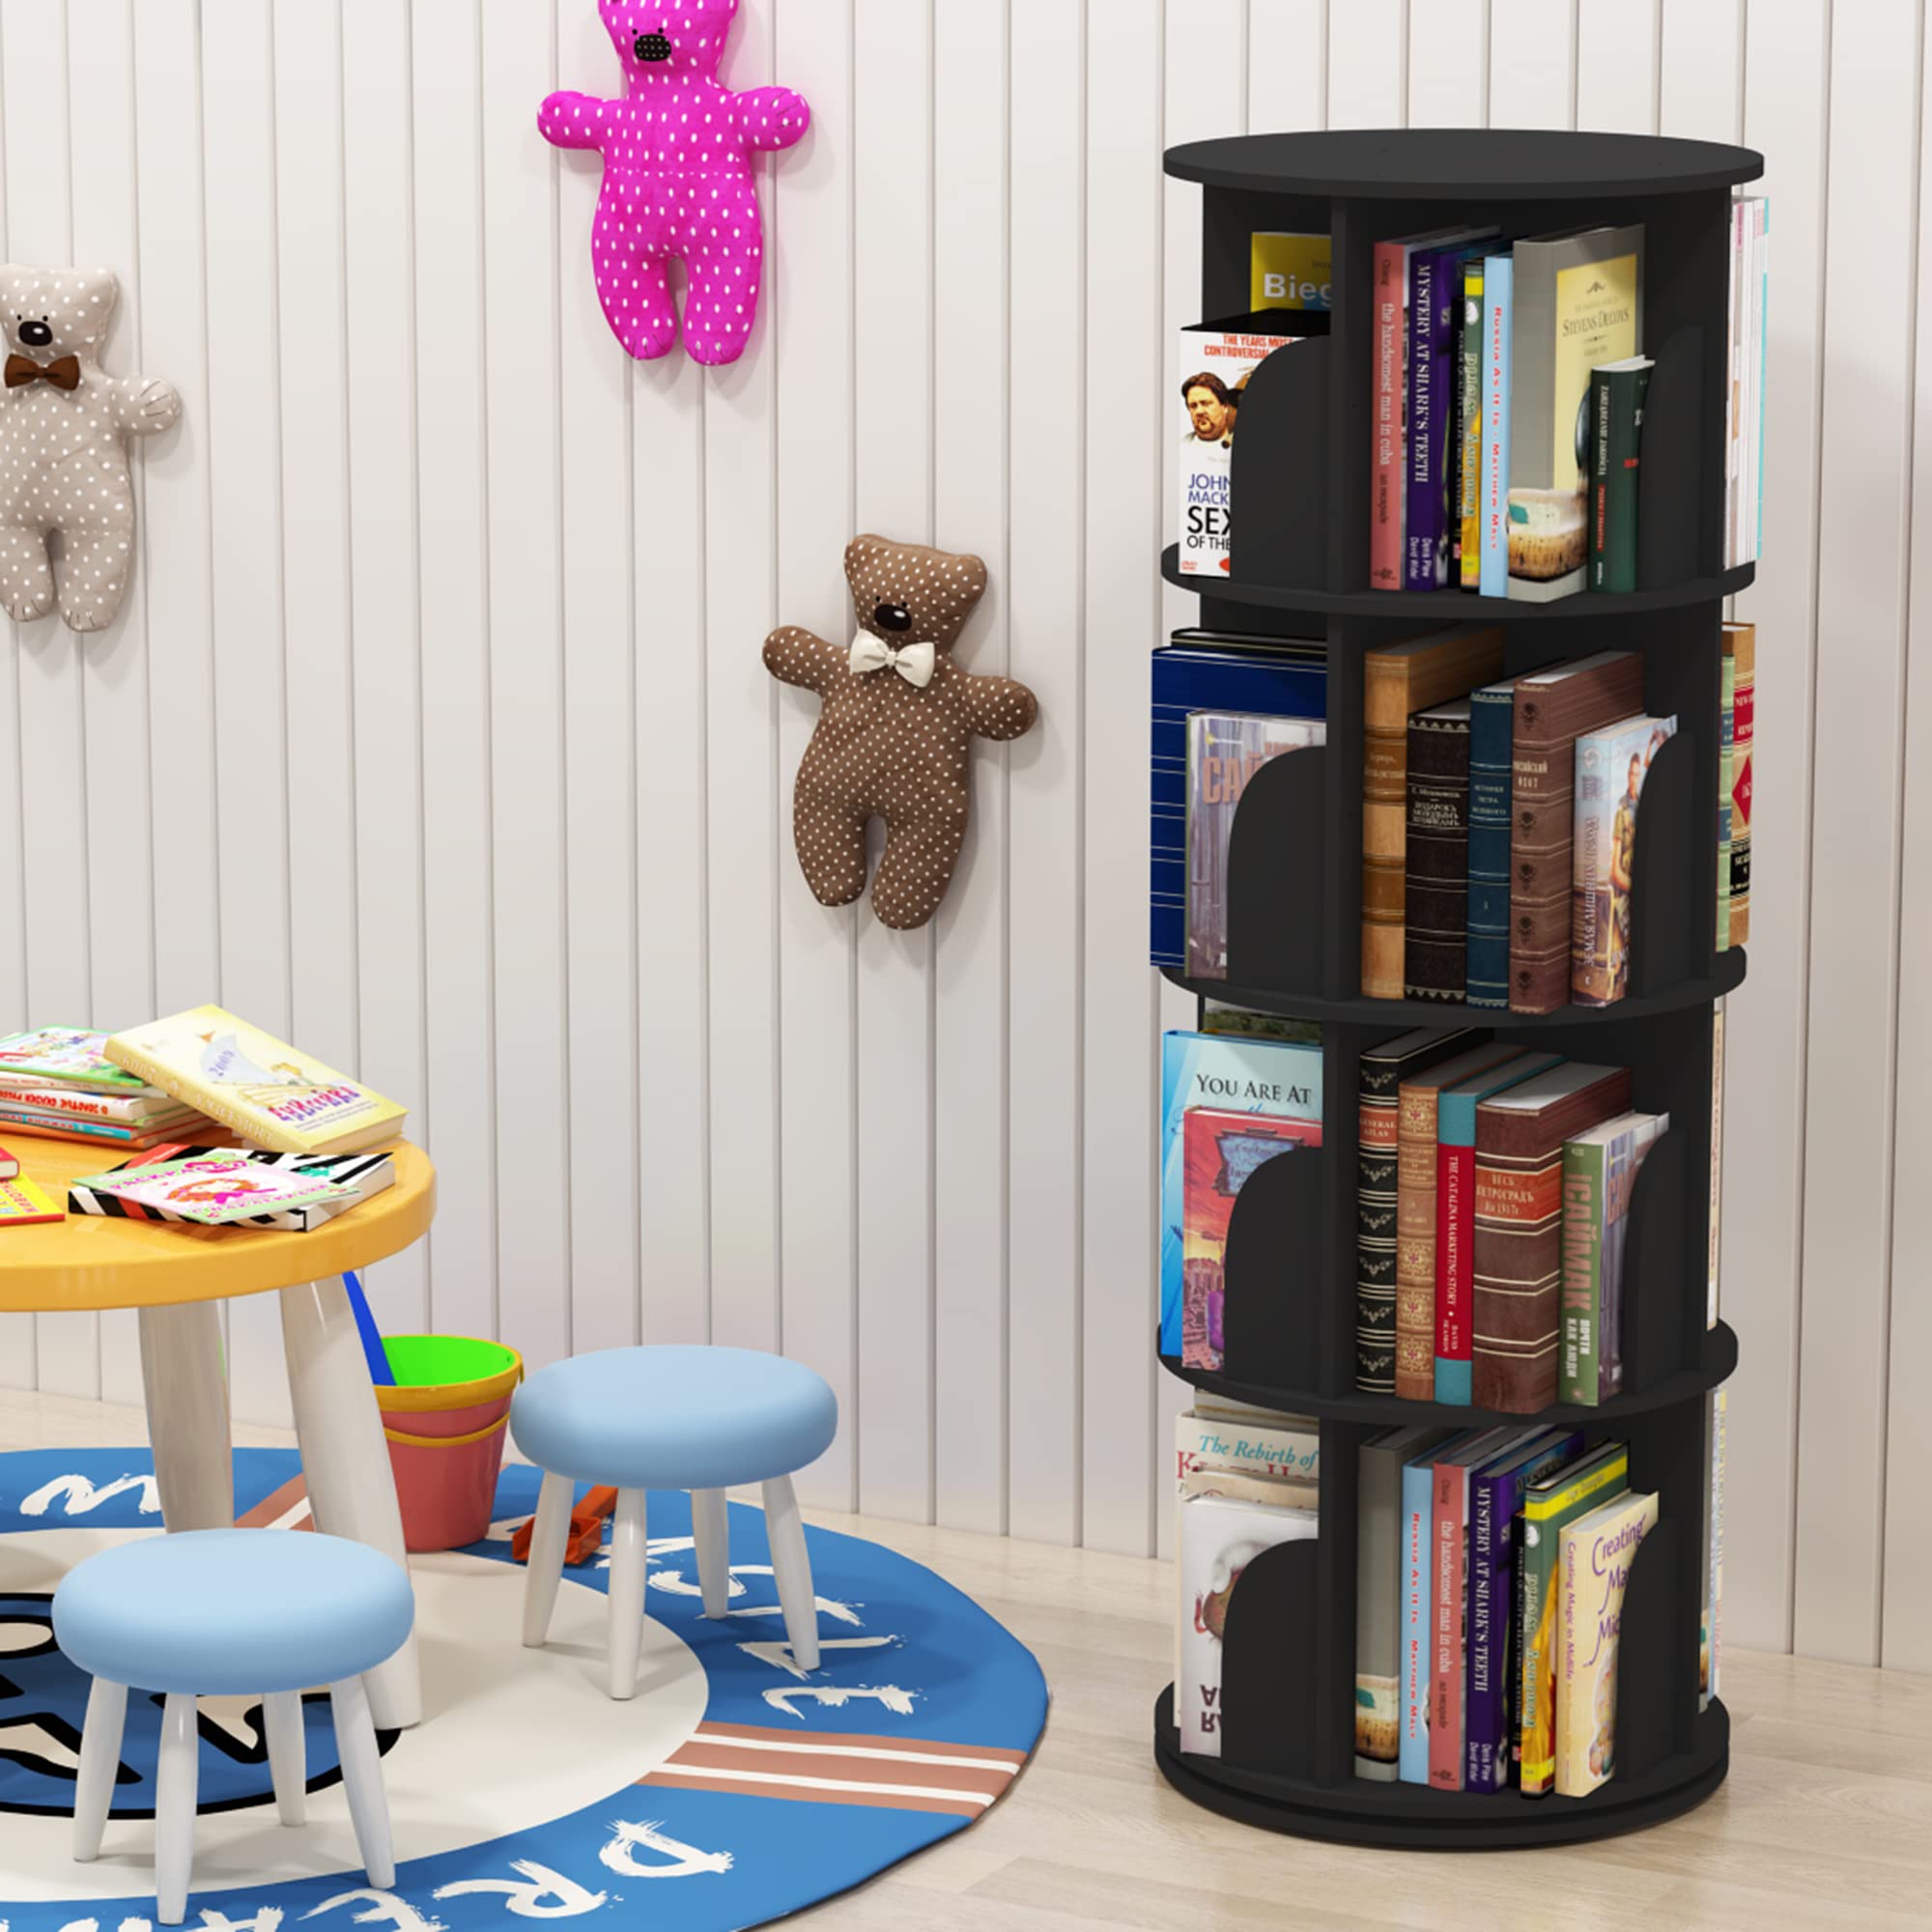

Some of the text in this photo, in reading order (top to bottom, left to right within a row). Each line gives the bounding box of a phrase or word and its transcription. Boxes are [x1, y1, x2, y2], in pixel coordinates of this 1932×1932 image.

[1222, 333, 1237, 345] THE
[1379, 302, 1394, 465] the handsomest man in cuba
[1414, 265, 1431, 483] MYSTERY AT SHARK'S TEETH
[1188, 491, 1229, 505] MACK
[1187, 535, 1231, 551] OF THE
[1196, 1074, 1312, 1105] YOU ARE AT
[1448, 1155, 1458, 1173] THE
[1447, 1222, 1458, 1274] MARKETING
[1564, 1182, 1597, 1311] САЙМАК
[1446, 1276, 1457, 1306] STORY
[1566, 1318, 1577, 1378] КАК ЛЮДИ
[1578, 1319, 1591, 1355] ПОЧТИ
[1199, 1435, 1229, 1457] The
[1234, 1439, 1295, 1465] Rebirth
[1300, 1449, 1319, 1470] of
[1565, 1541, 1577, 1589] Creating
[1438, 1520, 1455, 1673] the handsomest man in cuba
[1474, 1486, 1492, 1692] MYSTERY AT SHARK'S TEETH
[1565, 1592, 1576, 1625] Magic
[1566, 1628, 1575, 1639] in
